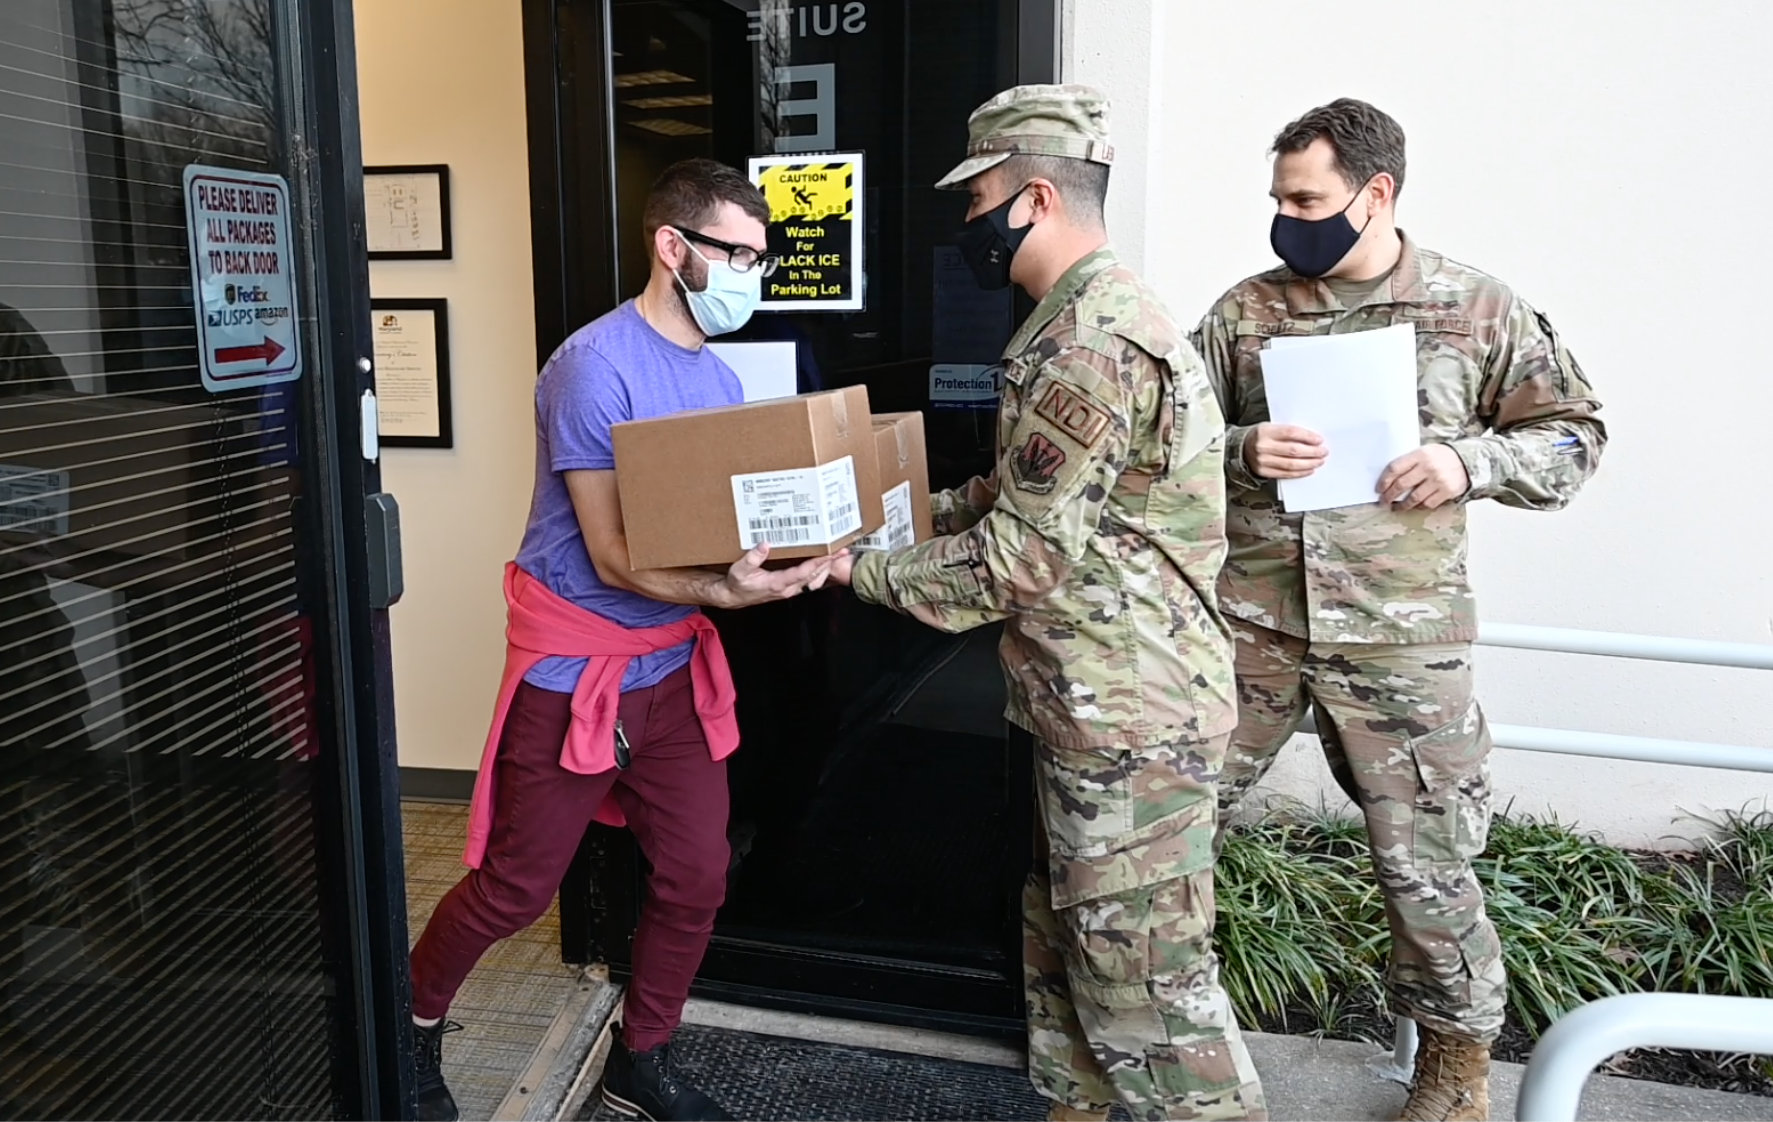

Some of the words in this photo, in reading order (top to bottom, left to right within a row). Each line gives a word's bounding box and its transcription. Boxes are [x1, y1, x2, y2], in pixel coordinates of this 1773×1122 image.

[779, 173, 828, 183] CAUTION
[198, 185, 237, 213] PLEASE
[238, 189, 278, 216] DELIVER
[207, 218, 226, 243] ALL
[227, 220, 277, 245] PACKAGES
[785, 226, 825, 238] Watch
[796, 242, 815, 251] For
[208, 250, 223, 274] TO
[224, 250, 252, 274] BACK
[253, 251, 279, 275] DOOR
[779, 255, 816, 267] LACK
[819, 254, 840, 266] ICE
[789, 271, 799, 280] In
[801, 270, 822, 280] The
[237, 285, 269, 303] FedEx
[771, 284, 817, 297] Parking
[821, 284, 841, 295] Lot
[223, 309, 253, 326] USPS
[254, 307, 288, 320] amazon
[1416, 320, 1430, 331] AIR
[1435, 320, 1471, 333] FORCE
[934, 377, 992, 390] Protection
